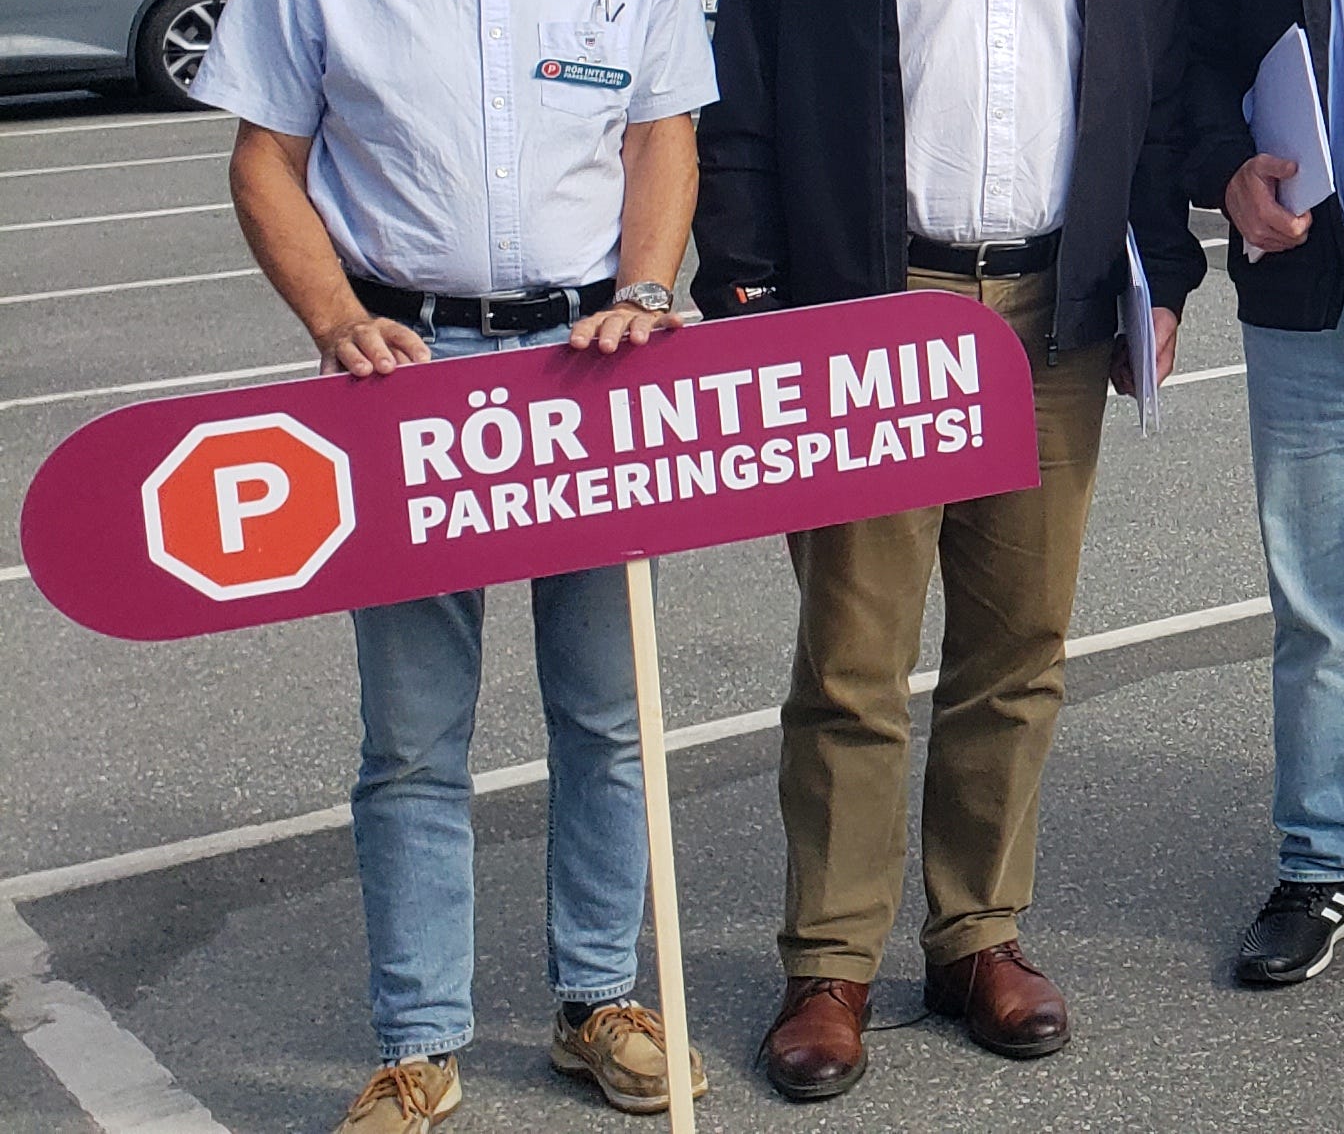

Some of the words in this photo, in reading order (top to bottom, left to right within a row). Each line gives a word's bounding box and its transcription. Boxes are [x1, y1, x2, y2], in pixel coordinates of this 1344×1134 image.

[565, 65, 583, 76] RÖR
[585, 68, 605, 79] INTE
[607, 70, 624, 81] MIN
[400, 387, 588, 487] RÖR
[609, 362, 808, 454] INTE
[829, 334, 980, 418] MIN
[214, 462, 290, 554] P
[408, 405, 984, 545] PARKERINGSPLATS!
